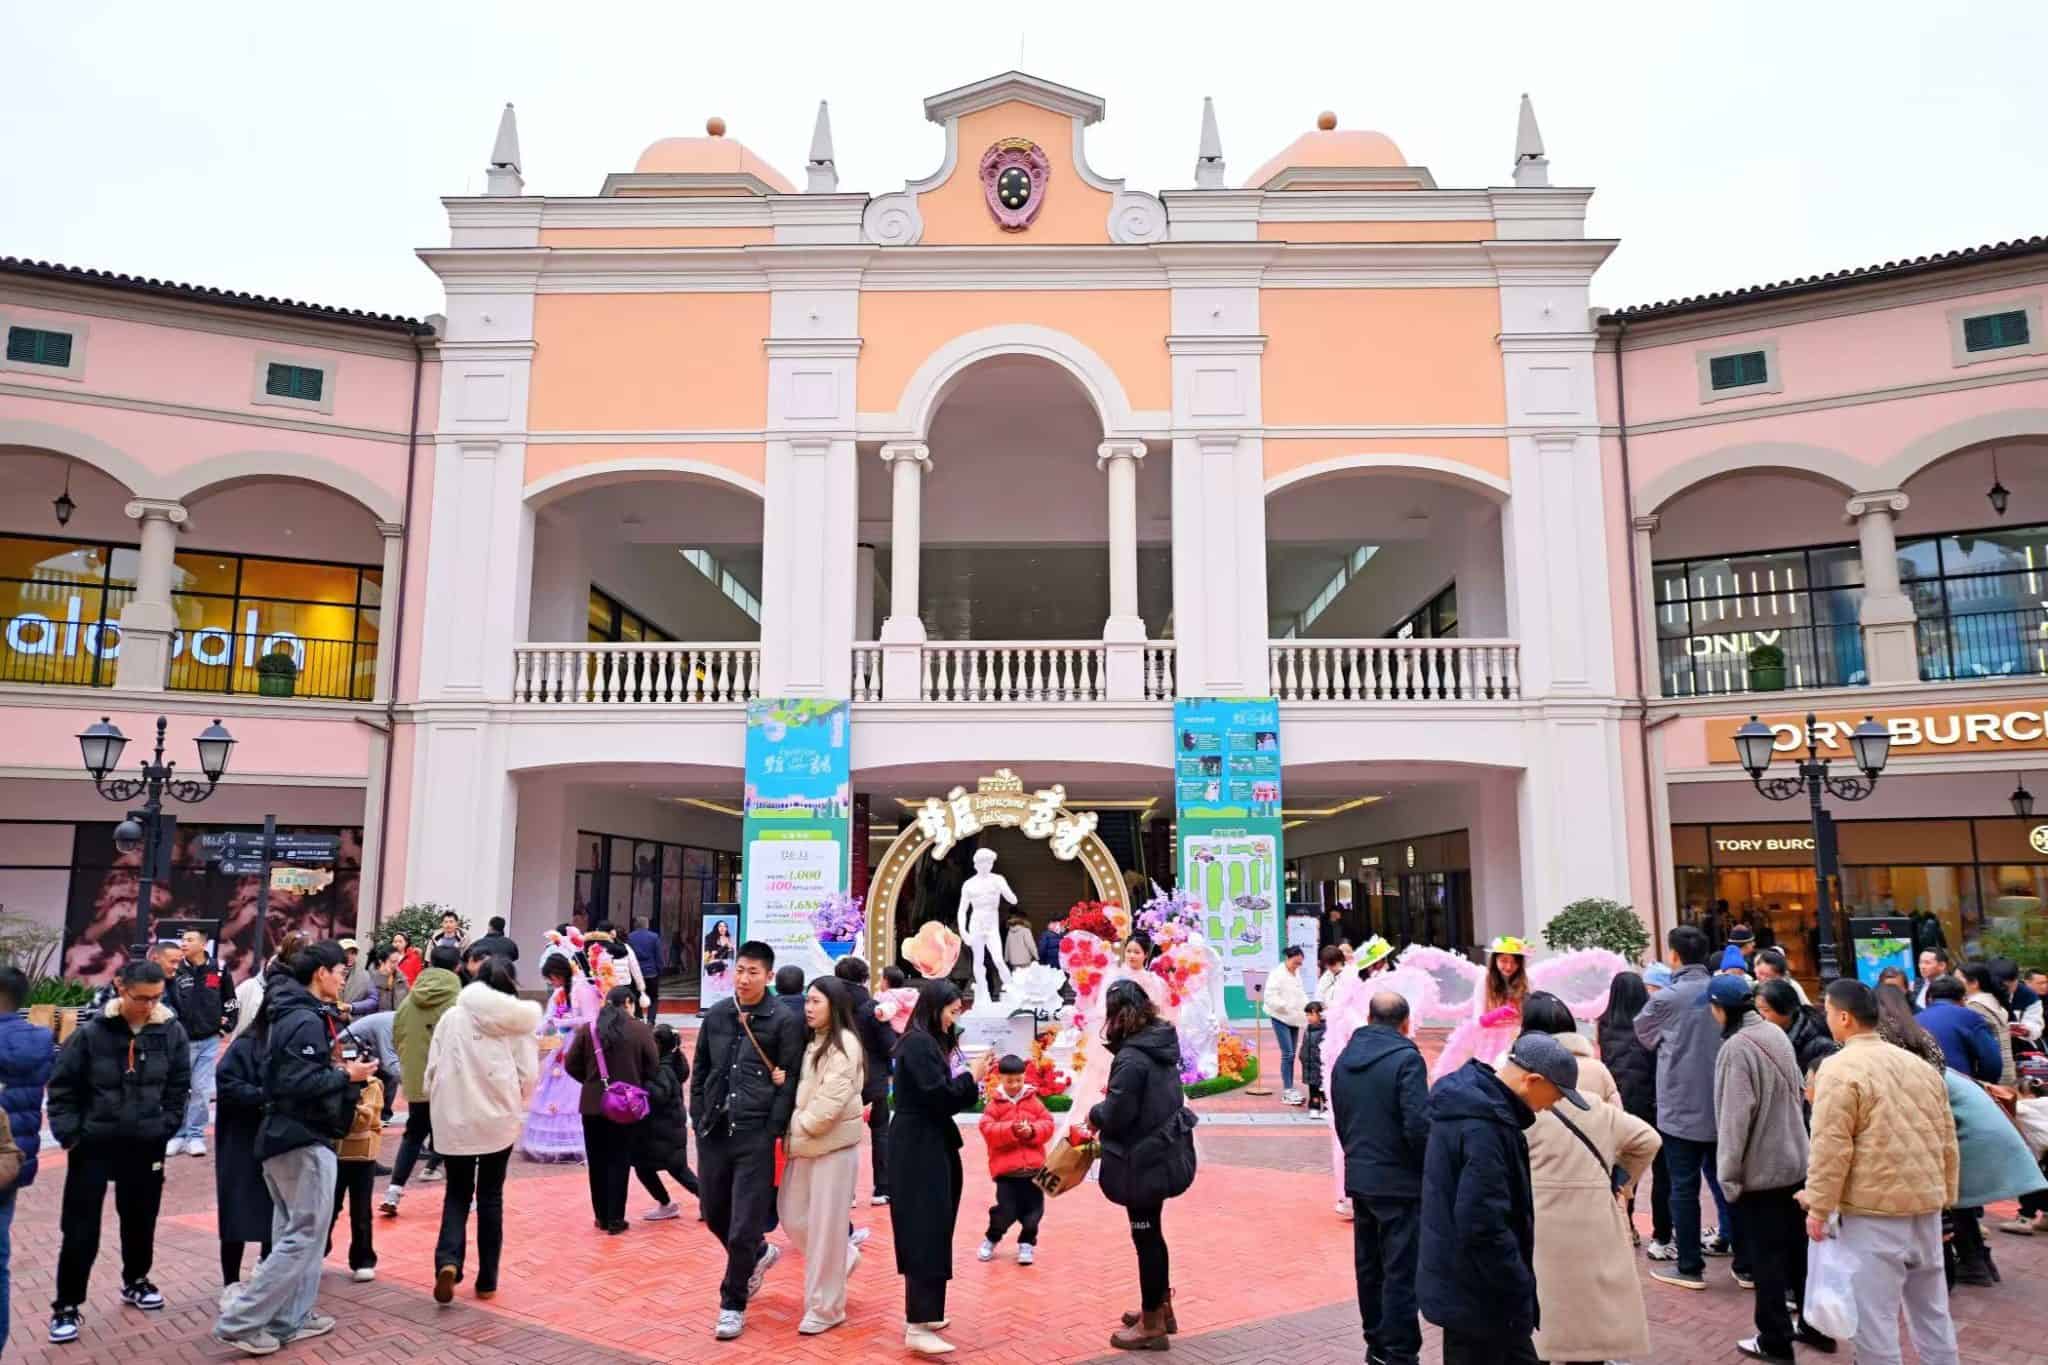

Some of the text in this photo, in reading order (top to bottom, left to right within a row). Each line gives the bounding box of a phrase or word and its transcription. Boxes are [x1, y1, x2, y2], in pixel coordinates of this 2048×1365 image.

[1685, 630, 1780, 657] ONLY
[1887, 711, 2048, 746] BURC
[1715, 838, 1816, 850] TORY BURC
